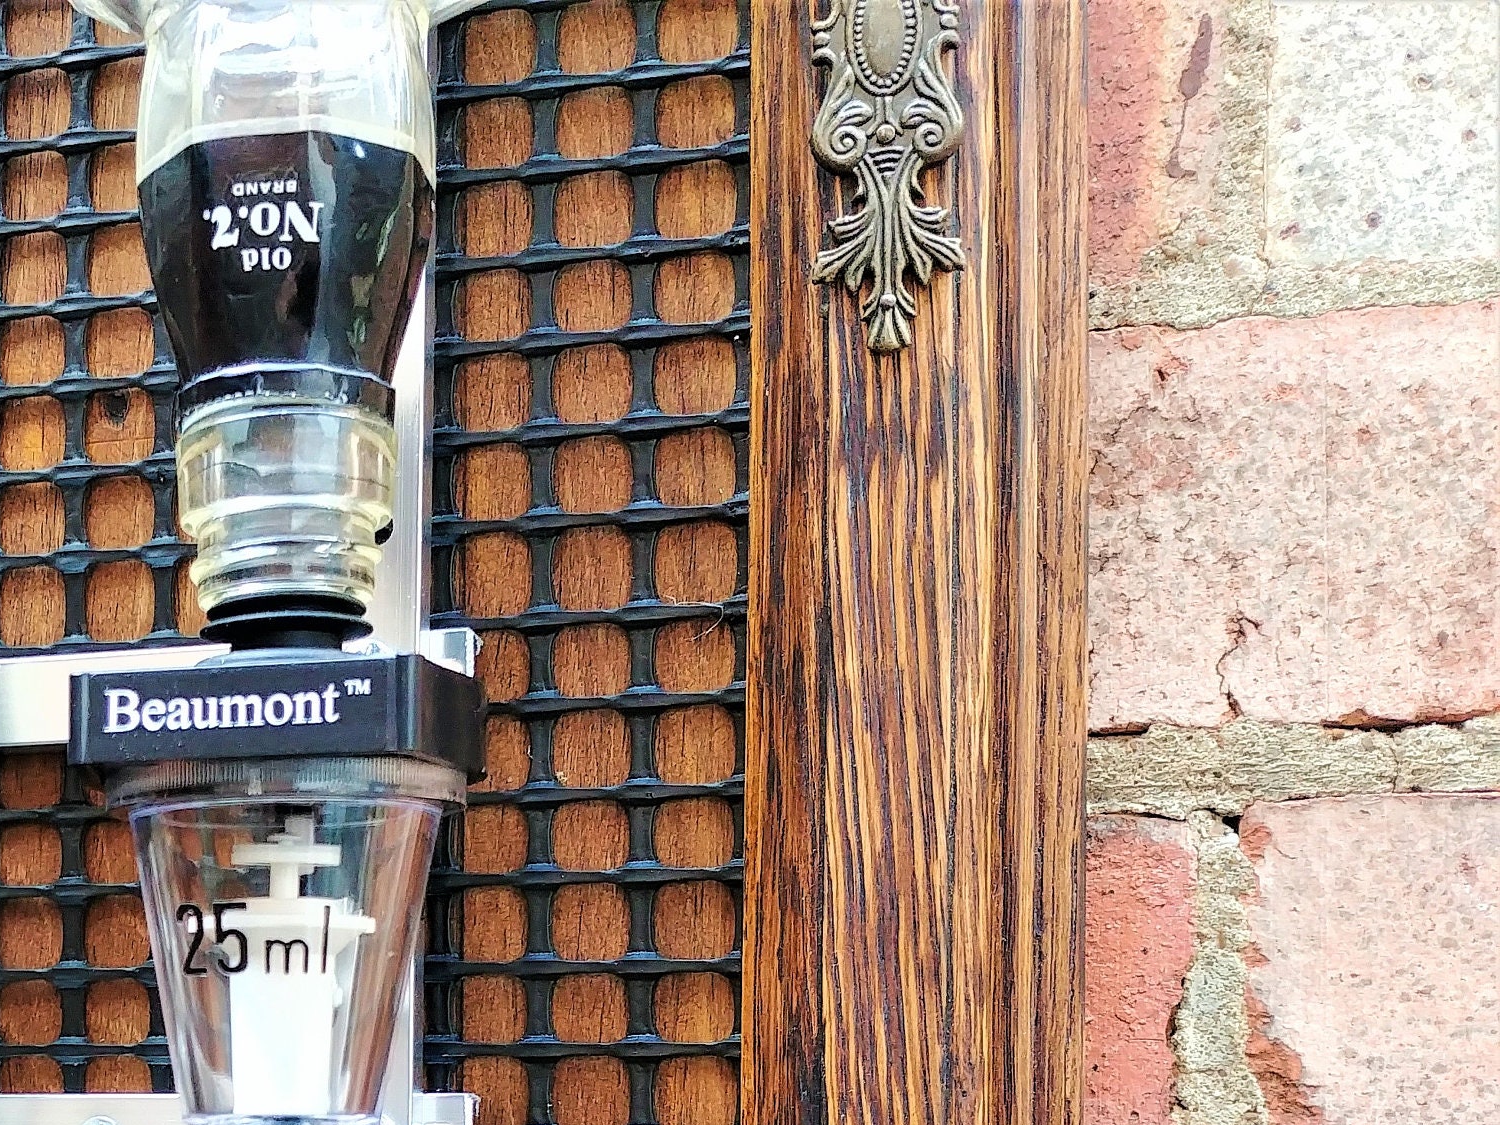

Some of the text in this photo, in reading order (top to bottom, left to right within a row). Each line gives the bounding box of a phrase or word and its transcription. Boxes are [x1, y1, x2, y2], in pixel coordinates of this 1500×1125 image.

[232, 179, 298, 196] BRAND
[240, 246, 292, 271] Old
[176, 902, 331, 977] 25 ml
